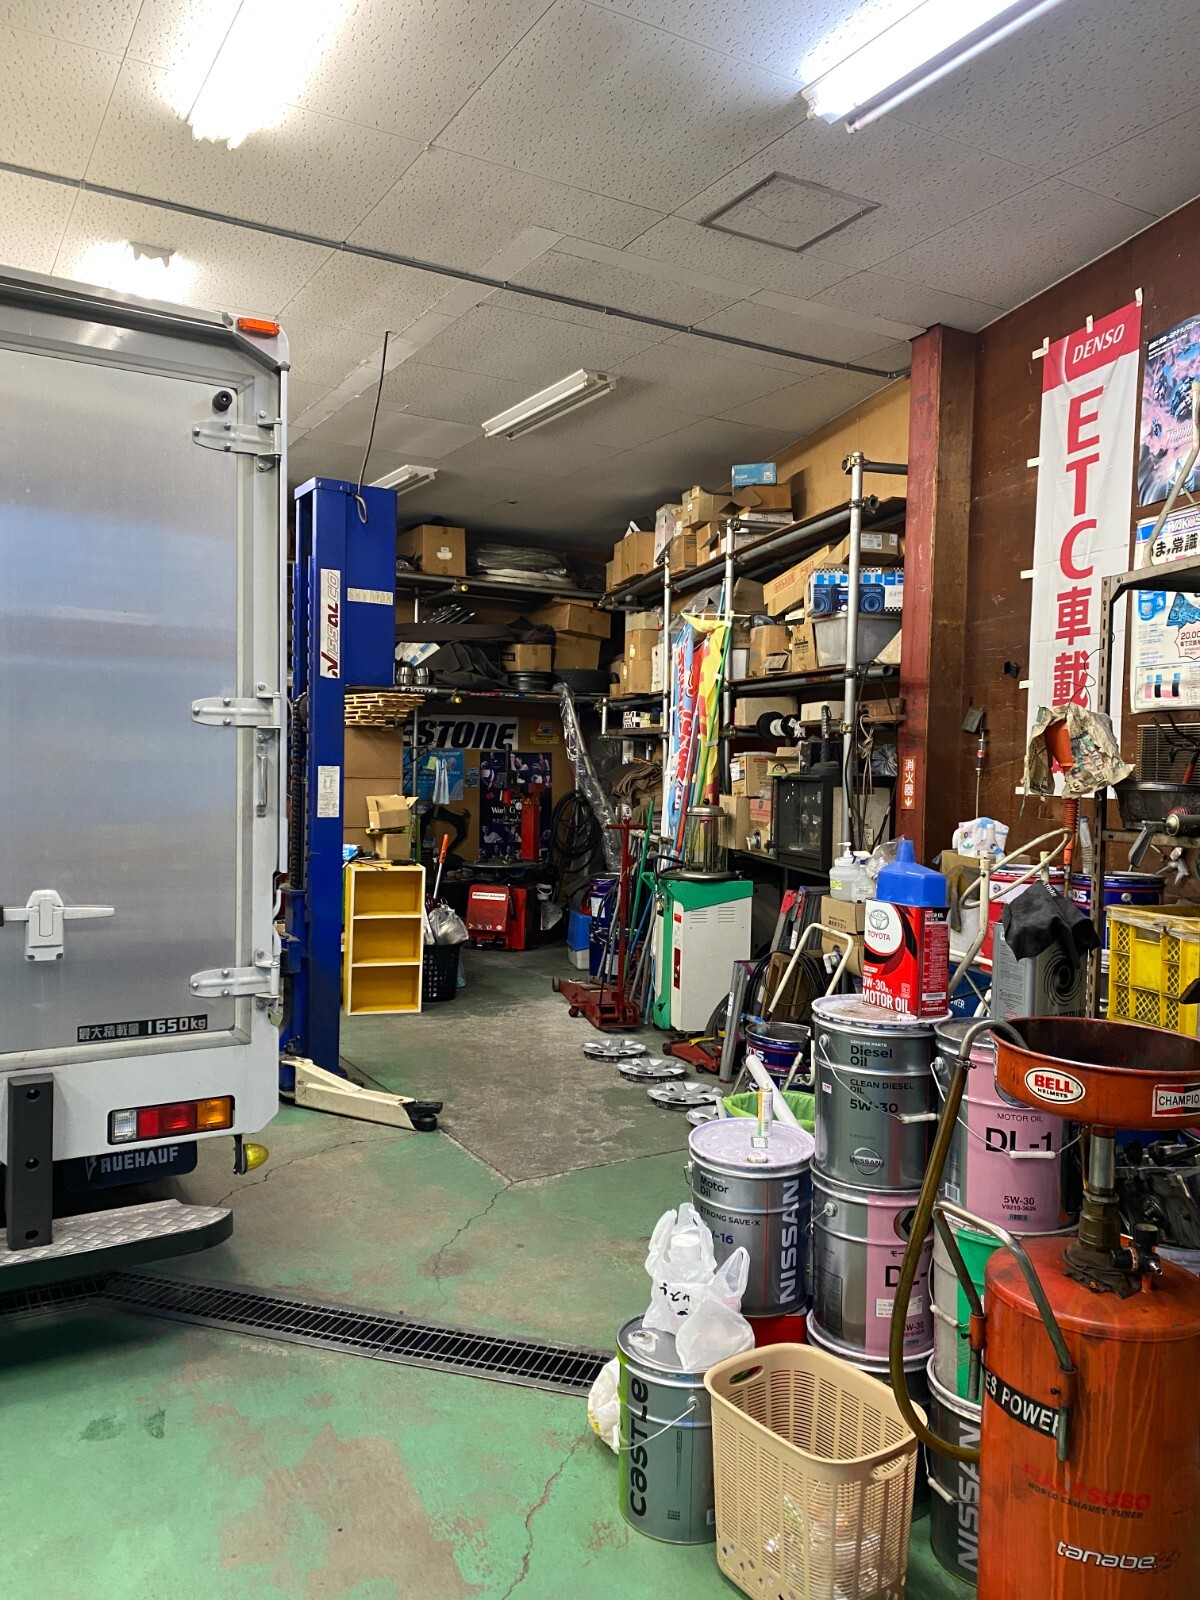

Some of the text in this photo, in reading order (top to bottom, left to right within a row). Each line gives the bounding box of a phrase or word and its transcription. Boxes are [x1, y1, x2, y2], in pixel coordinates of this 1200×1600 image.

[1072, 324, 1125, 364] DENSO
[1051, 385, 1105, 773] ETC車載
[904, 759, 914, 796] 消火器
[867, 930, 891, 941] TOYOTA
[862, 987, 911, 1014] MOTOR OIL
[79, 1022, 140, 1040] 最大積載量
[851, 1045, 893, 1058] Diesel
[850, 1056, 867, 1067] Oil
[850, 1079, 914, 1090] CLEAN DIESEL
[850, 1085, 865, 1095] OIL
[1034, 1074, 1073, 1094] BELL
[1037, 1087, 1068, 1099] HELMETS
[850, 1098, 899, 1113] 5W-30
[997, 1112, 1029, 1122] MOTOR
[985, 1126, 1052, 1153] DL-1
[852, 1156, 880, 1166] NISSAN
[700, 1177, 729, 1194] Motor
[700, 1185, 711, 1198] Oil
[1004, 1195, 1035, 1206] 5W-30
[700, 1205, 727, 1222] STRONG
[779, 1179, 800, 1304] NISSAN
[903, 1320, 925, 1333] W-30
[1022, 1462, 1152, 1511] FUTSUBO
[1028, 1481, 1144, 1520] WORLD EXHAUST TUNER
[1057, 1540, 1156, 1570] tanabe
